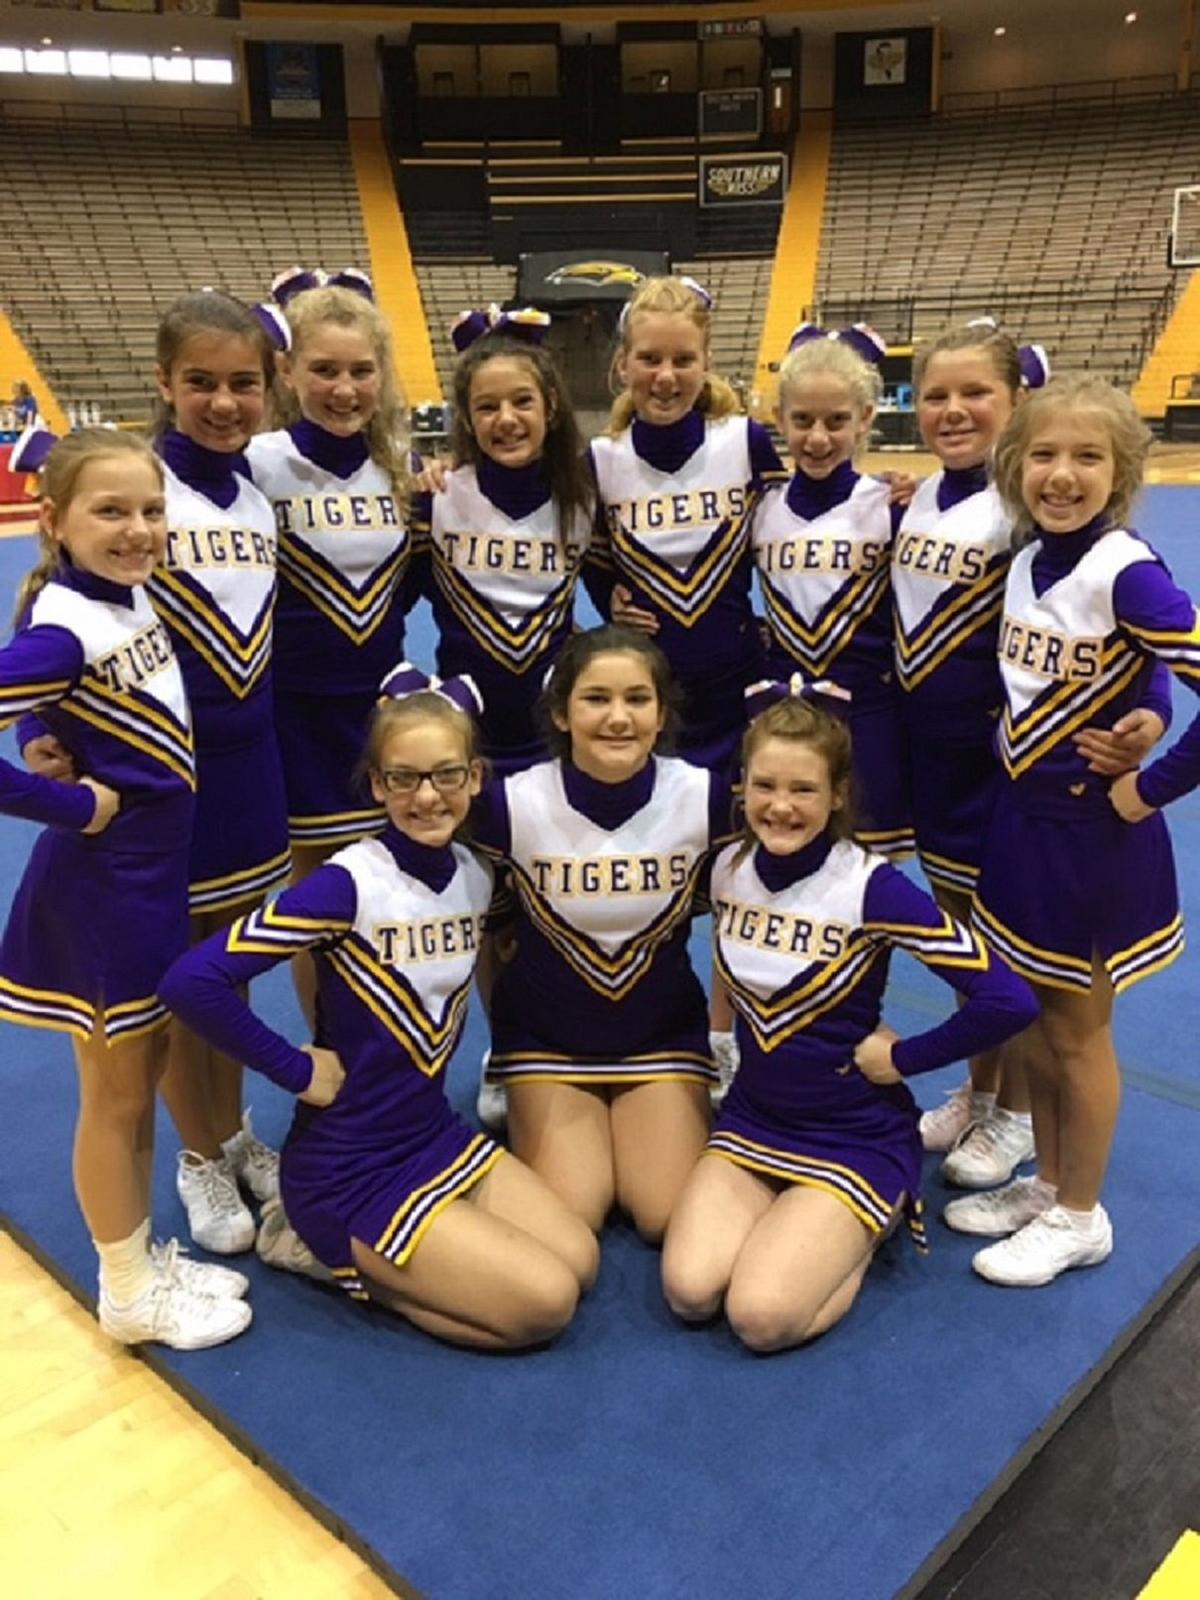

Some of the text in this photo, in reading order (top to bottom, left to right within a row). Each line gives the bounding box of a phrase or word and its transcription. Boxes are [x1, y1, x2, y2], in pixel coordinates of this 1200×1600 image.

[707, 164, 781, 185] SOUTHERN
[275, 496, 411, 529] TIGER
[608, 488, 744, 532] TIGERS
[443, 531, 580, 572] TIGERS
[899, 533, 984, 581] GERS
[997, 620, 1098, 678] IGERS
[533, 854, 686, 892] TIGERS
[716, 899, 844, 959] TIGERS
